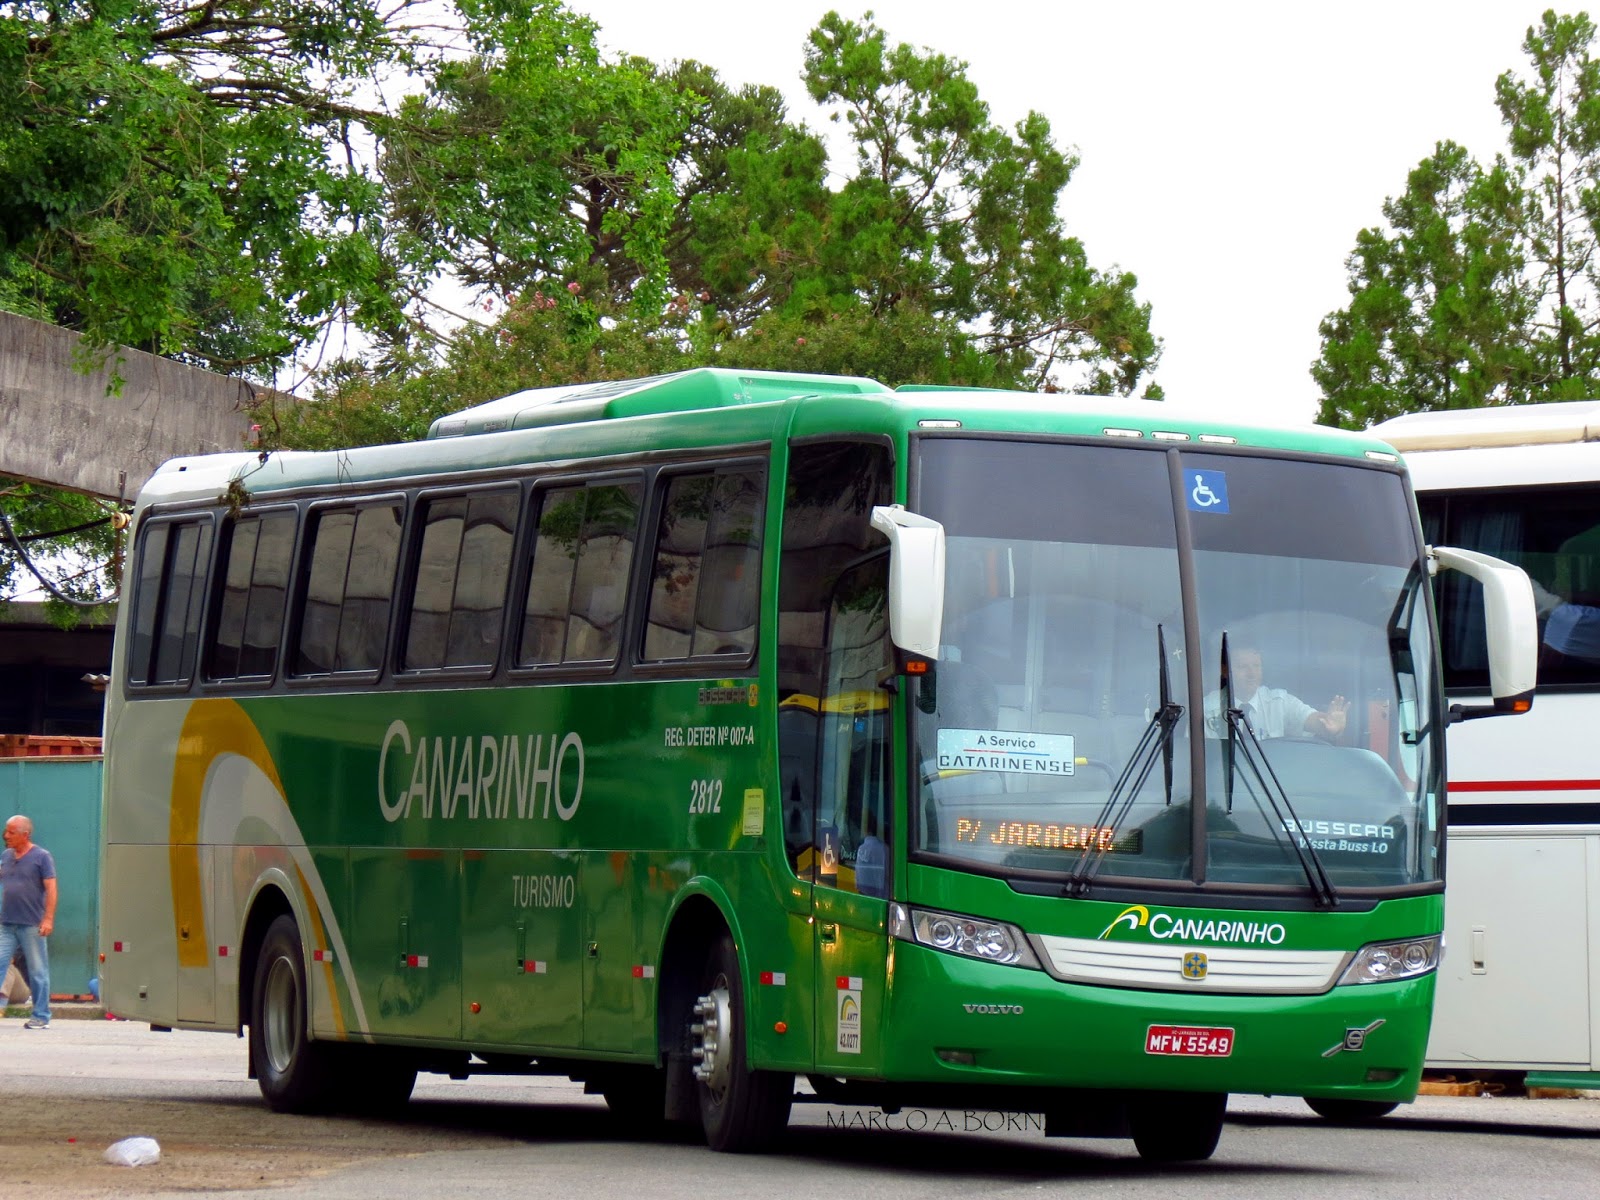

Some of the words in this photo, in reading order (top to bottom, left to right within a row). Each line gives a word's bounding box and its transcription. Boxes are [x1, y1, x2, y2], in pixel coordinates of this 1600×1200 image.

[664, 727, 685, 747] REG.
[687, 726, 716, 746] DETER
[730, 725, 755, 746] 007-A
[977, 734, 987, 746] A
[990, 735, 1036, 750] Serviço
[378, 719, 585, 822] CANARINHO
[939, 755, 1073, 773] CATARINENSE
[688, 779, 723, 814] 2812
[956, 817, 981, 842] P/
[1281, 818, 1395, 839] BUSSCAR
[1338, 839, 1369, 852] Buss
[512, 875, 575, 908] TURISMO
[1149, 913, 1286, 945] CANARINHO
[962, 1003, 1024, 1016] VOLVO
